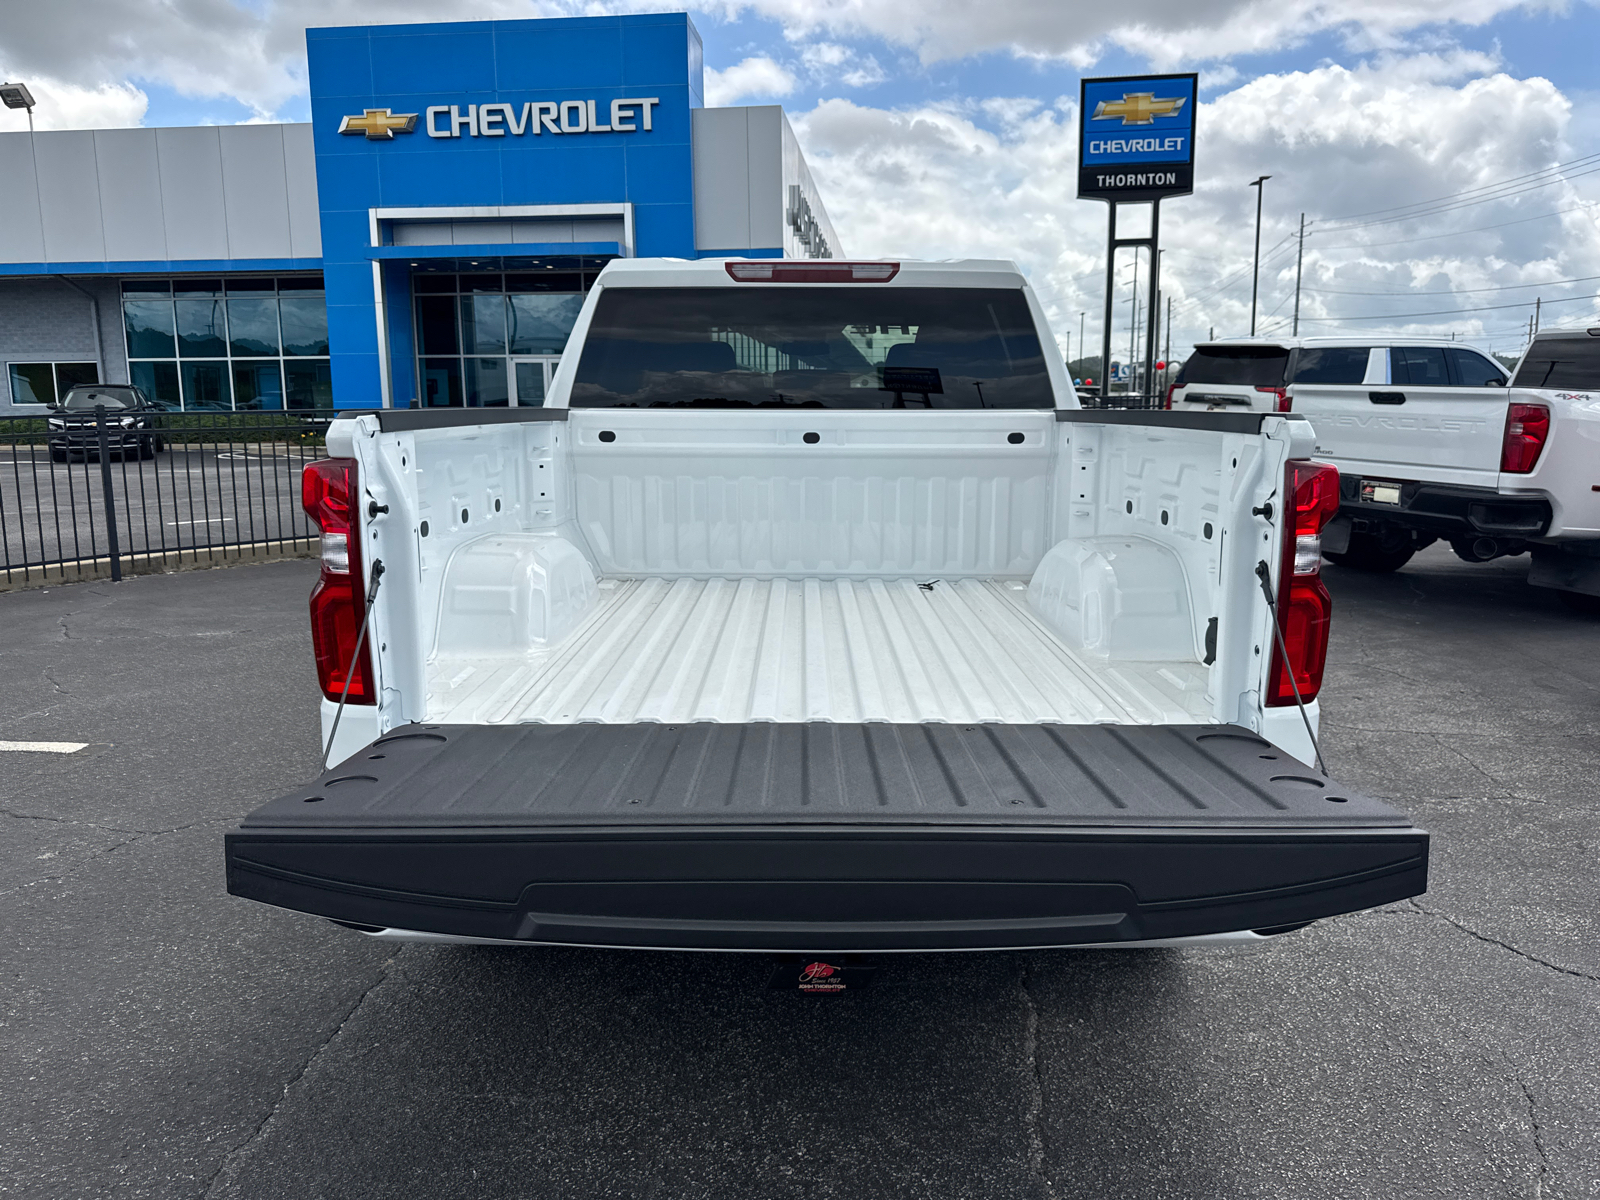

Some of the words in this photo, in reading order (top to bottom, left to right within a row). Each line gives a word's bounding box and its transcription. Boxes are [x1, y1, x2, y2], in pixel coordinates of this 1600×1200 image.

[426, 97, 660, 138] CHEVROLET
[1089, 137, 1185, 154] CHEVROLET
[1097, 172, 1176, 187] THORNTON
